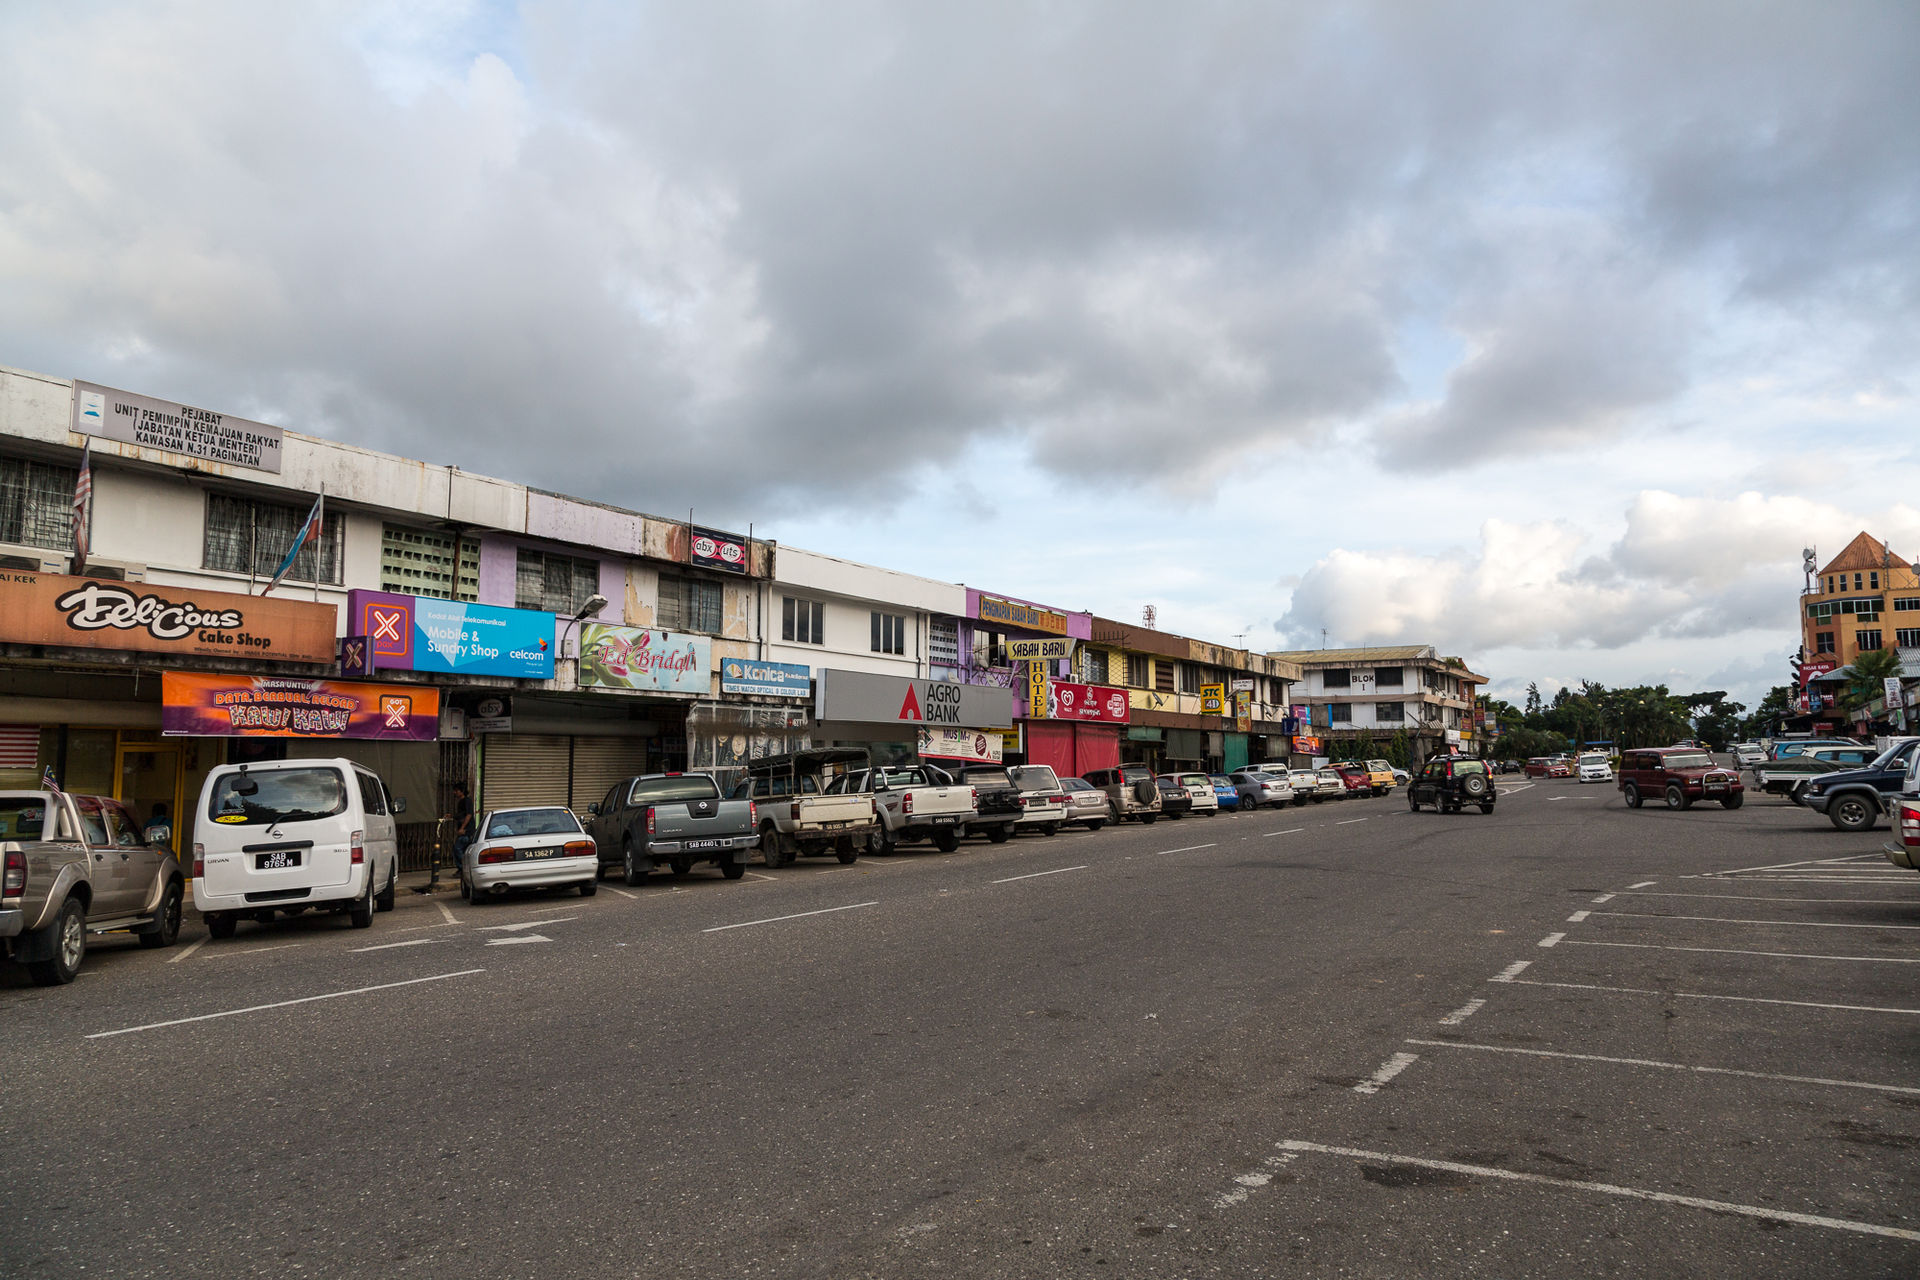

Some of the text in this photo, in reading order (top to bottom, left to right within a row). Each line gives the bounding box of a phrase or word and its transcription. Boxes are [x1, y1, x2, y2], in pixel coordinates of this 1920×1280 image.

[182, 407, 222, 425] PEJABAT
[115, 403, 279, 449] UNIT PEMIMPIN KEMAJUAN RAKYAT
[133, 418, 263, 457] (JABATAN KETUA MENTERI)
[135, 431, 260, 466] KAWASAN N.31 PAGINATAN
[696, 540, 738, 557] abx uts
[14, 575, 37, 584] KEK
[198, 630, 272, 649] Cake Shop
[428, 626, 480, 642] Mobile &
[377, 640, 393, 648] pax
[427, 640, 499, 659] Sundry Shop
[1012, 641, 1066, 657] SABAH BARU
[509, 649, 544, 661] celcom
[634, 646, 696, 671] Bridal
[744, 664, 785, 683] Konica
[262, 680, 312, 690] MASA UNTUK
[741, 685, 756, 693] WATCH
[756, 686, 774, 694] OPTICAL
[780, 688, 797, 696] COLOUR
[926, 684, 961, 703] AGRO
[1032, 661, 1044, 718] HOTEL
[1203, 688, 1219, 697] STC
[312, 695, 356, 709] RELOAD
[926, 704, 960, 723] BANK
[264, 858, 293, 868] 9765 M
[270, 852, 286, 861] SAB
